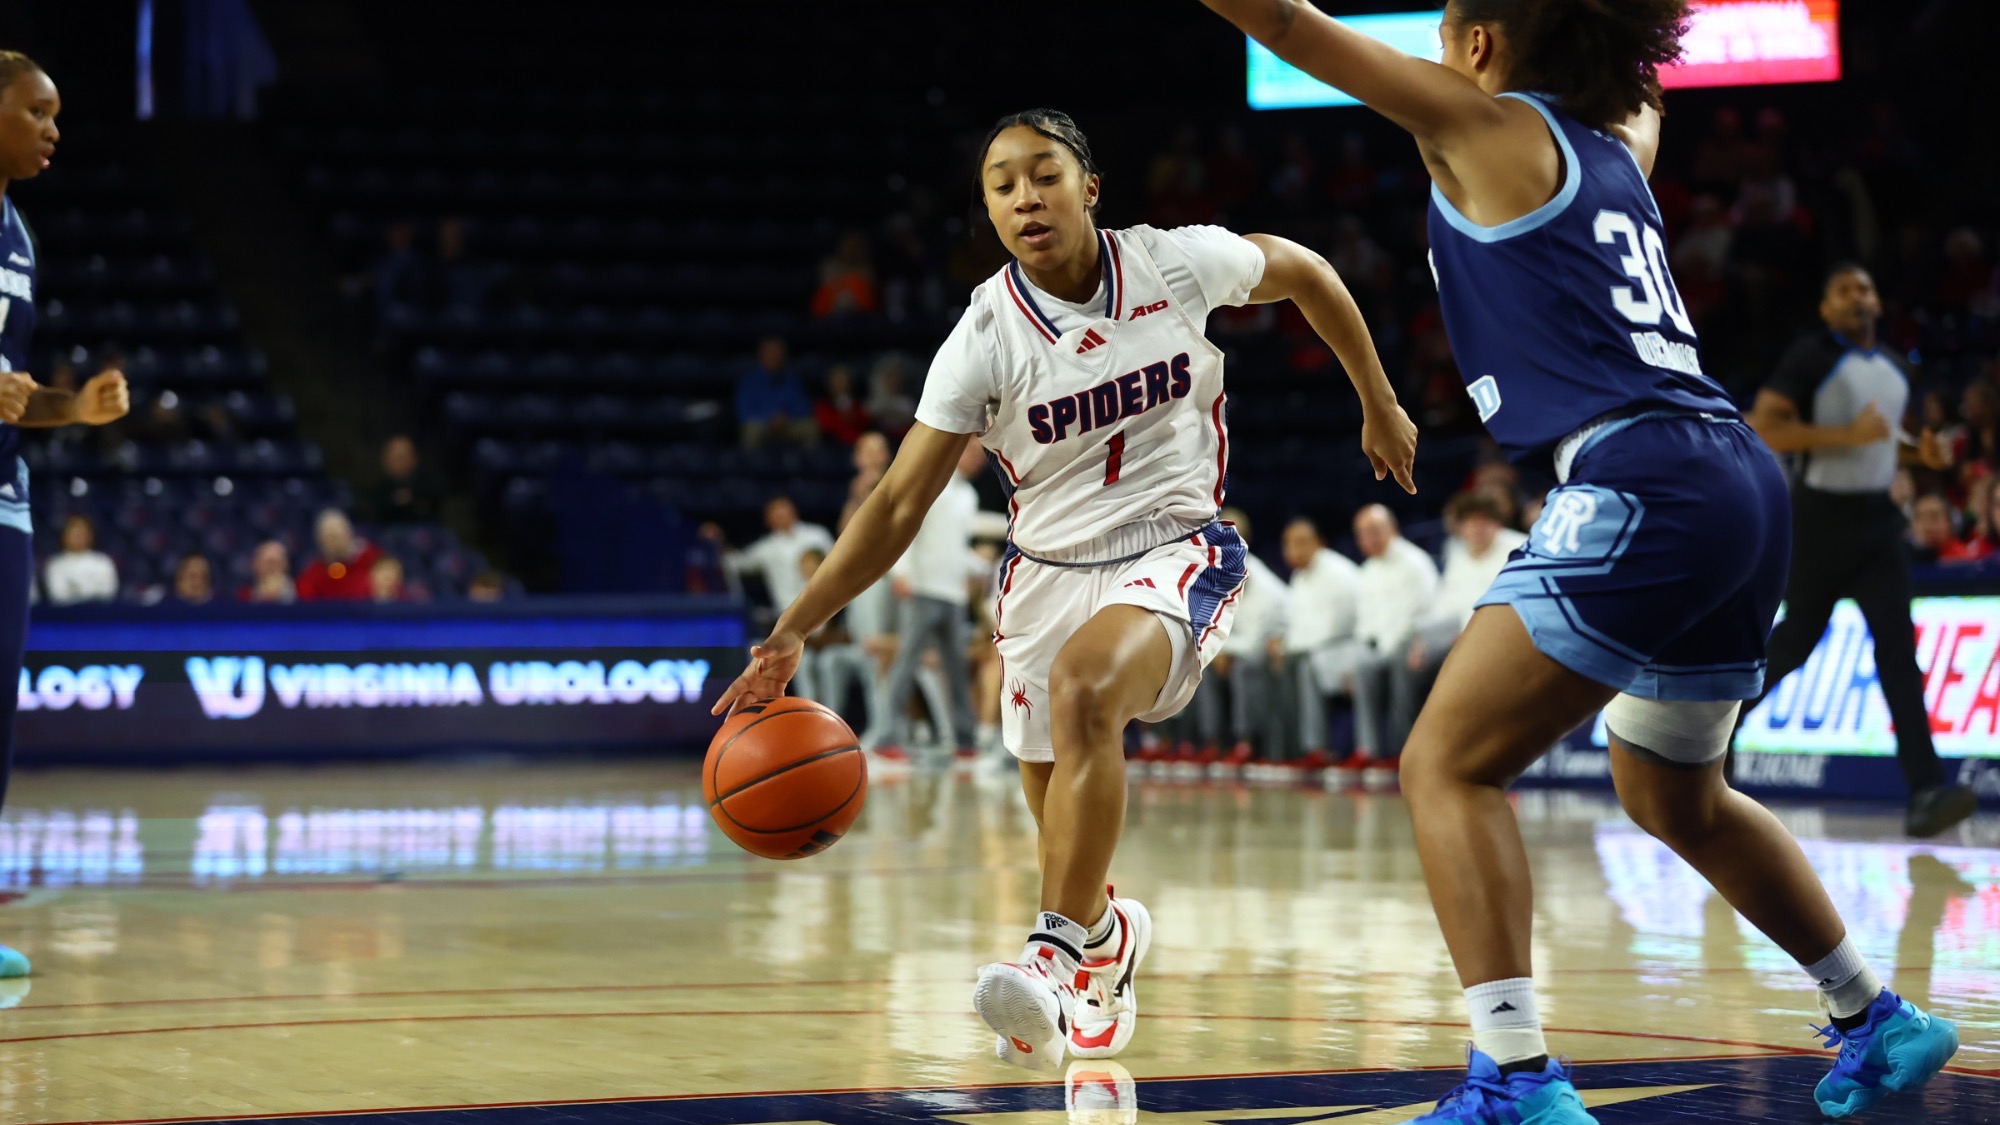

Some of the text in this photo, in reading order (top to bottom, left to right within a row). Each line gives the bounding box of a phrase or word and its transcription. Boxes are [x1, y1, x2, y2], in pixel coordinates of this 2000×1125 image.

[1592, 209, 1697, 338] 30
[1128, 299, 1168, 321] A10
[1028, 352, 1191, 444] SPIDERS
[1103, 429, 1125, 487] 1
[268, 661, 483, 708] VIRGINIA
[488, 658, 711, 707] UROLOGY
